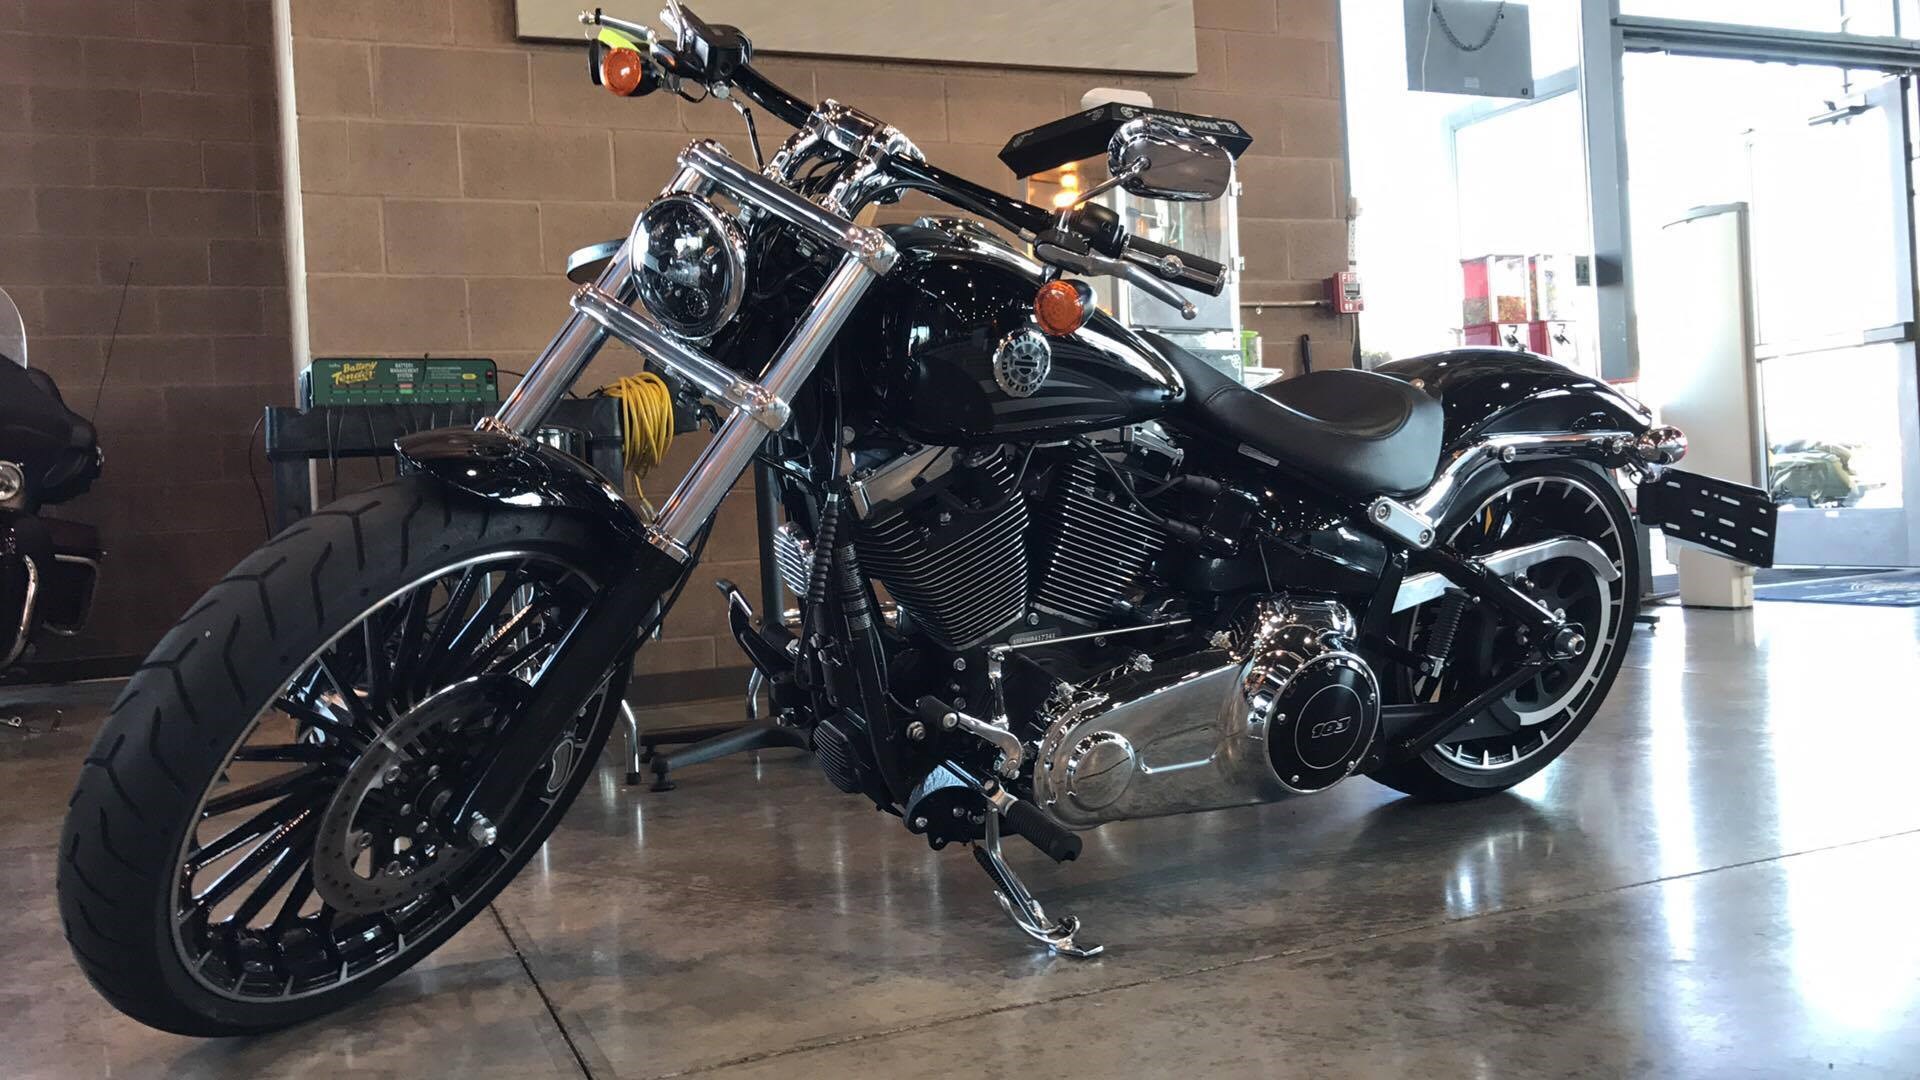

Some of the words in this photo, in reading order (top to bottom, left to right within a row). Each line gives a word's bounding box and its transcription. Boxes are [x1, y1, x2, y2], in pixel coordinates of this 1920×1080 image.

[1185, 118, 1221, 131] POPPER
[343, 361, 377, 374] Battery
[331, 369, 376, 385] Tender
[1311, 716, 1352, 739] 103
